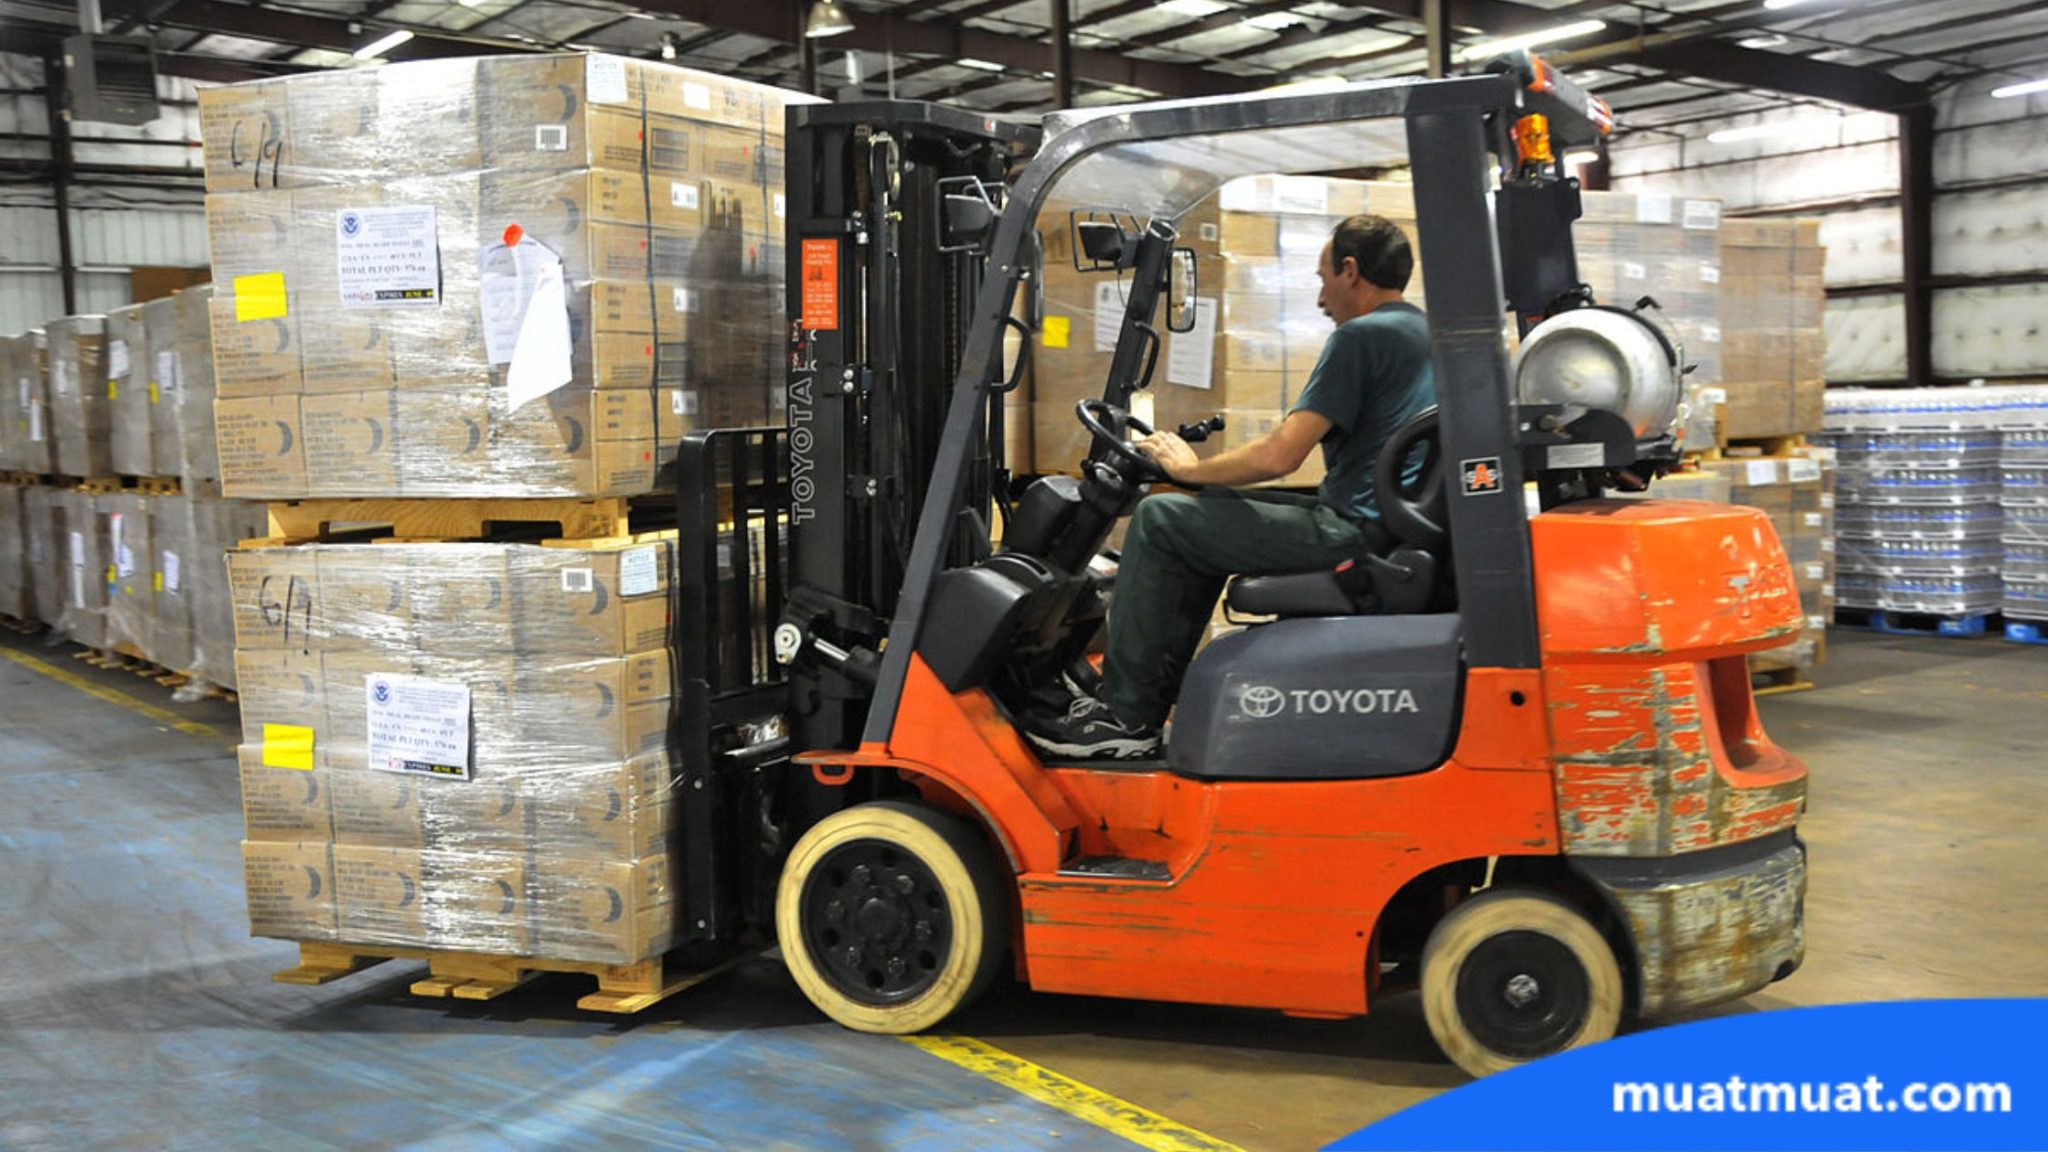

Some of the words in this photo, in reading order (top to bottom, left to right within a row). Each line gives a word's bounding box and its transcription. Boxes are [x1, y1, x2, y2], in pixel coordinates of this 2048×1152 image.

[341, 266, 366, 274] TOTAL
[789, 376, 815, 525] TOYOTA
[1290, 689, 1419, 713] TOYOTA
